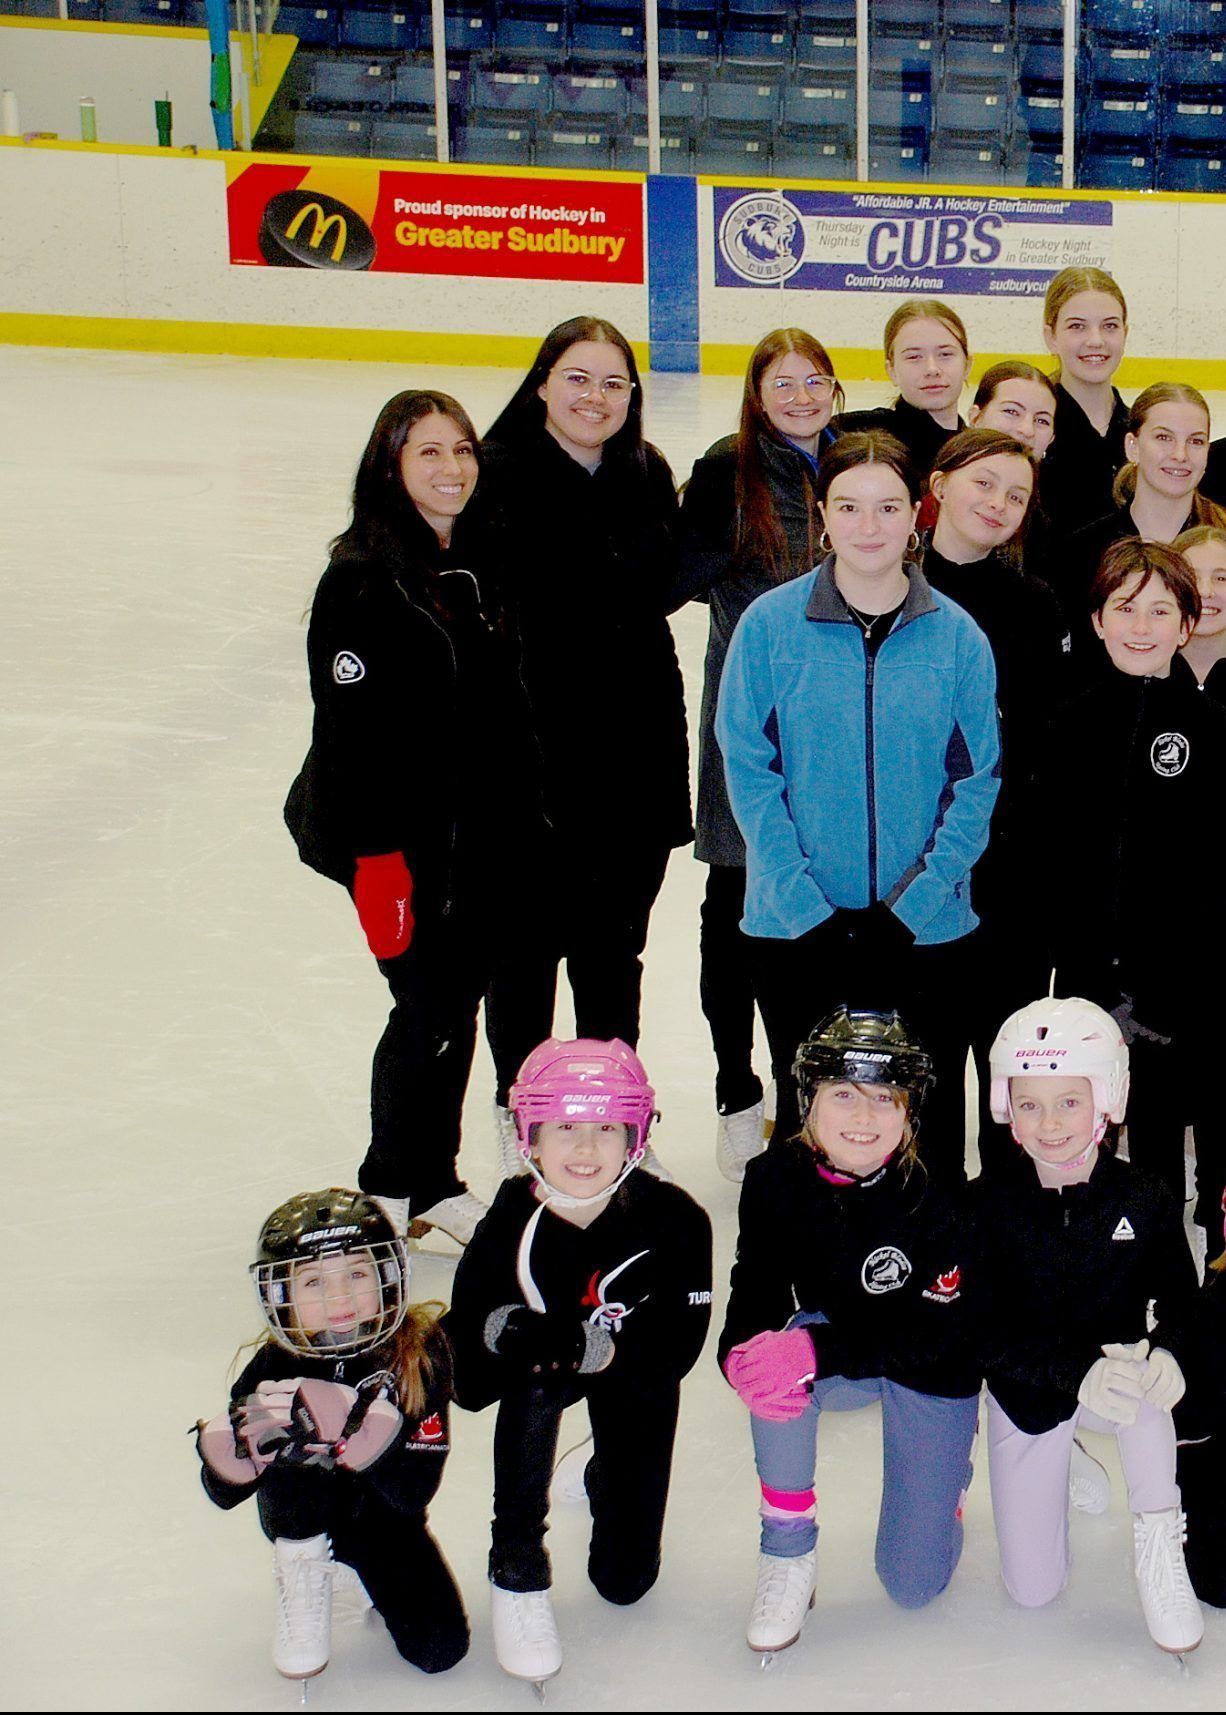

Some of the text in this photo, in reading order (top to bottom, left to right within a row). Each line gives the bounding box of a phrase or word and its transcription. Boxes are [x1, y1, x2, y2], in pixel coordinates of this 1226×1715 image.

[394, 198, 606, 226] Proud sponsor of Hockey in
[734, 202, 790, 225] SUDBUR
[915, 198, 933, 210] JR.
[934, 199, 944, 210] A
[946, 199, 987, 214] Hockey
[816, 221, 865, 235] Thursday
[395, 221, 625, 263] Greater Sudbury
[819, 235, 861, 248] Night is
[866, 213, 1003, 272] CUBS
[1020, 238, 1092, 253] Hockey Night
[1006, 252, 1106, 268] in Greater Sudbury
[748, 263, 781, 275] CUBS
[845, 273, 943, 289] Countryside Arena
[843, 1051, 893, 1063] BAUER
[1016, 1048, 1067, 1058] BAUER
[562, 1094, 612, 1103] BAUER
[299, 1225, 361, 1244] BAUER
[688, 1291, 712, 1305] TUR
